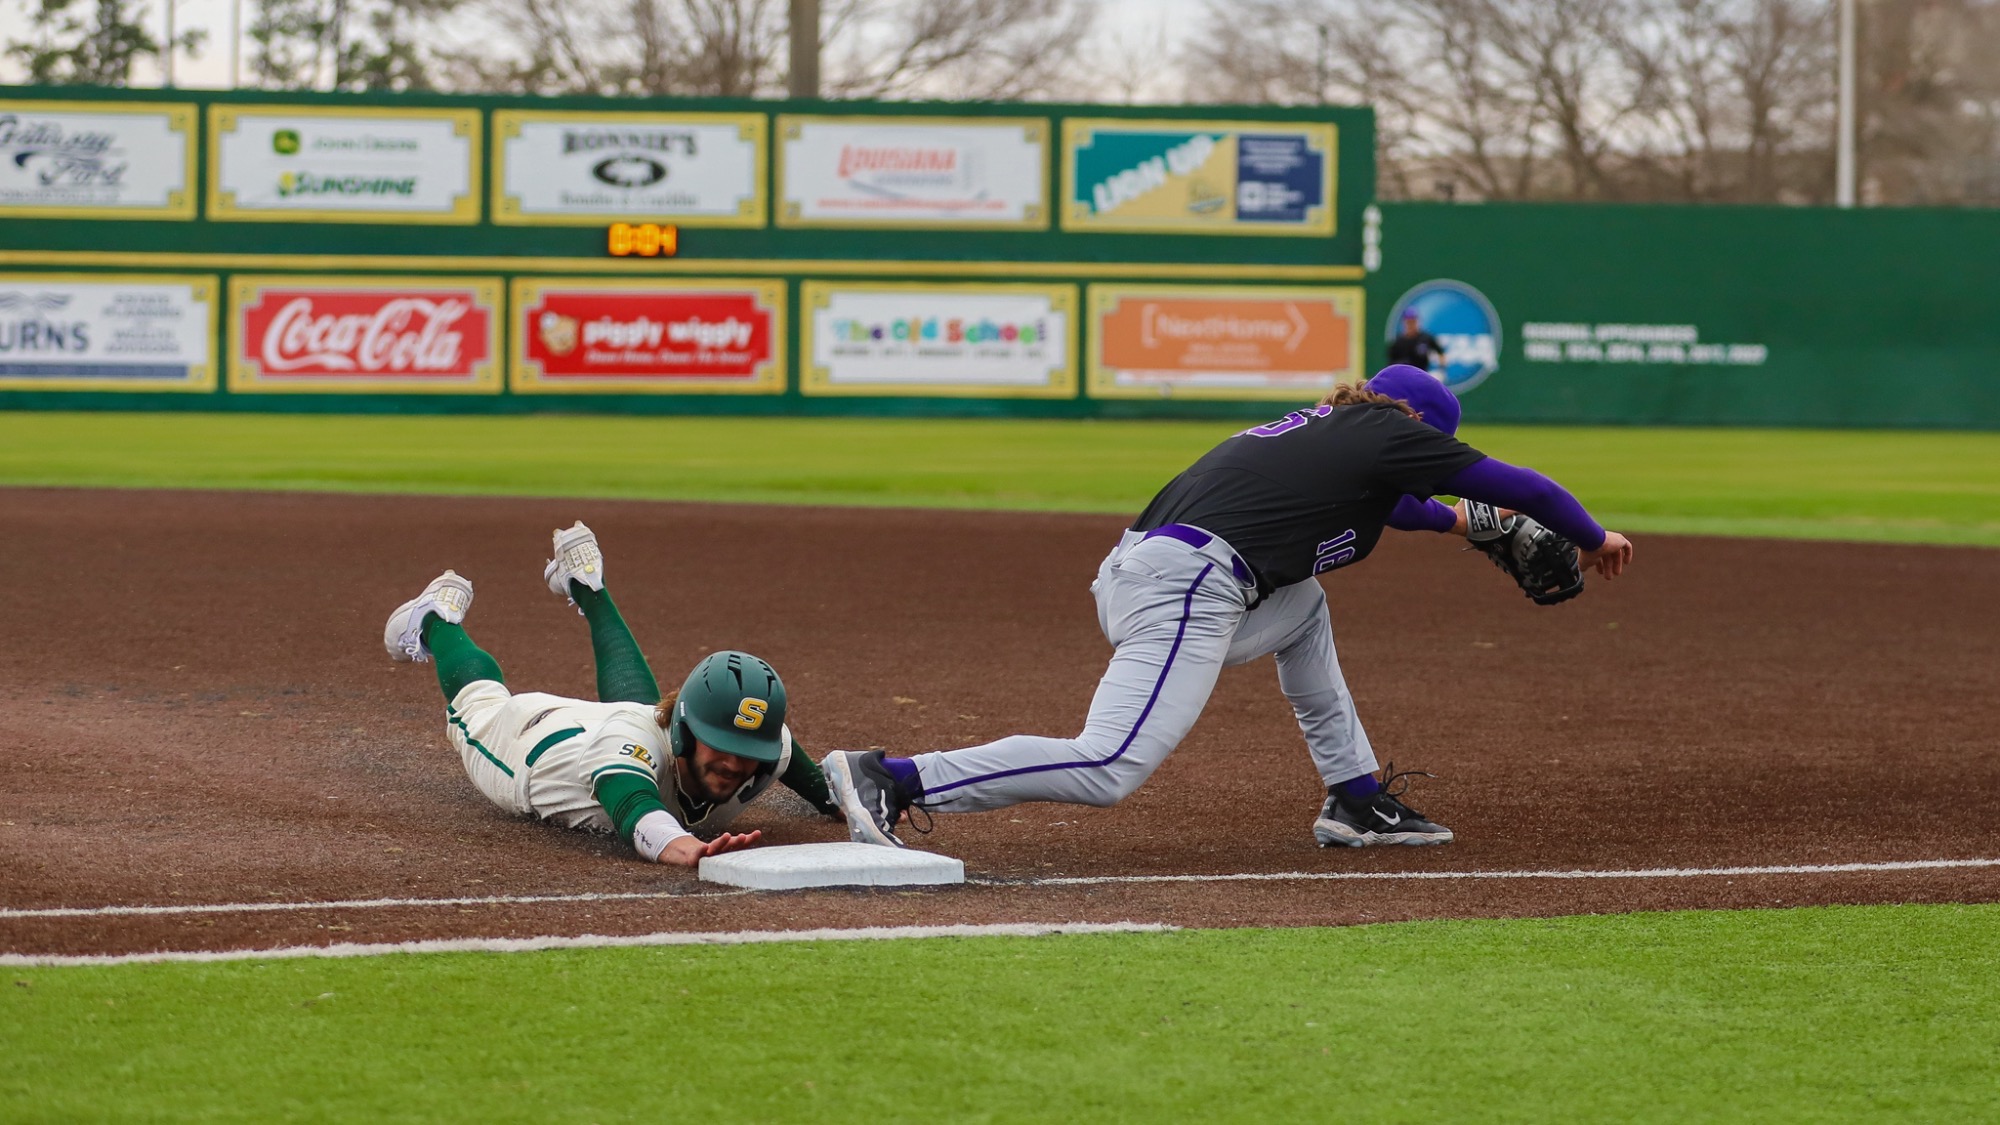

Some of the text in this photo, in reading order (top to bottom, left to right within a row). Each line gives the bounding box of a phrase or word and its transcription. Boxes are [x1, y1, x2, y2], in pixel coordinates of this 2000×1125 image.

[583, 316, 752, 349] piggly wiggly
[837, 318, 882, 342] The
[892, 317, 938, 344] Old
[734, 697, 769, 730] S
